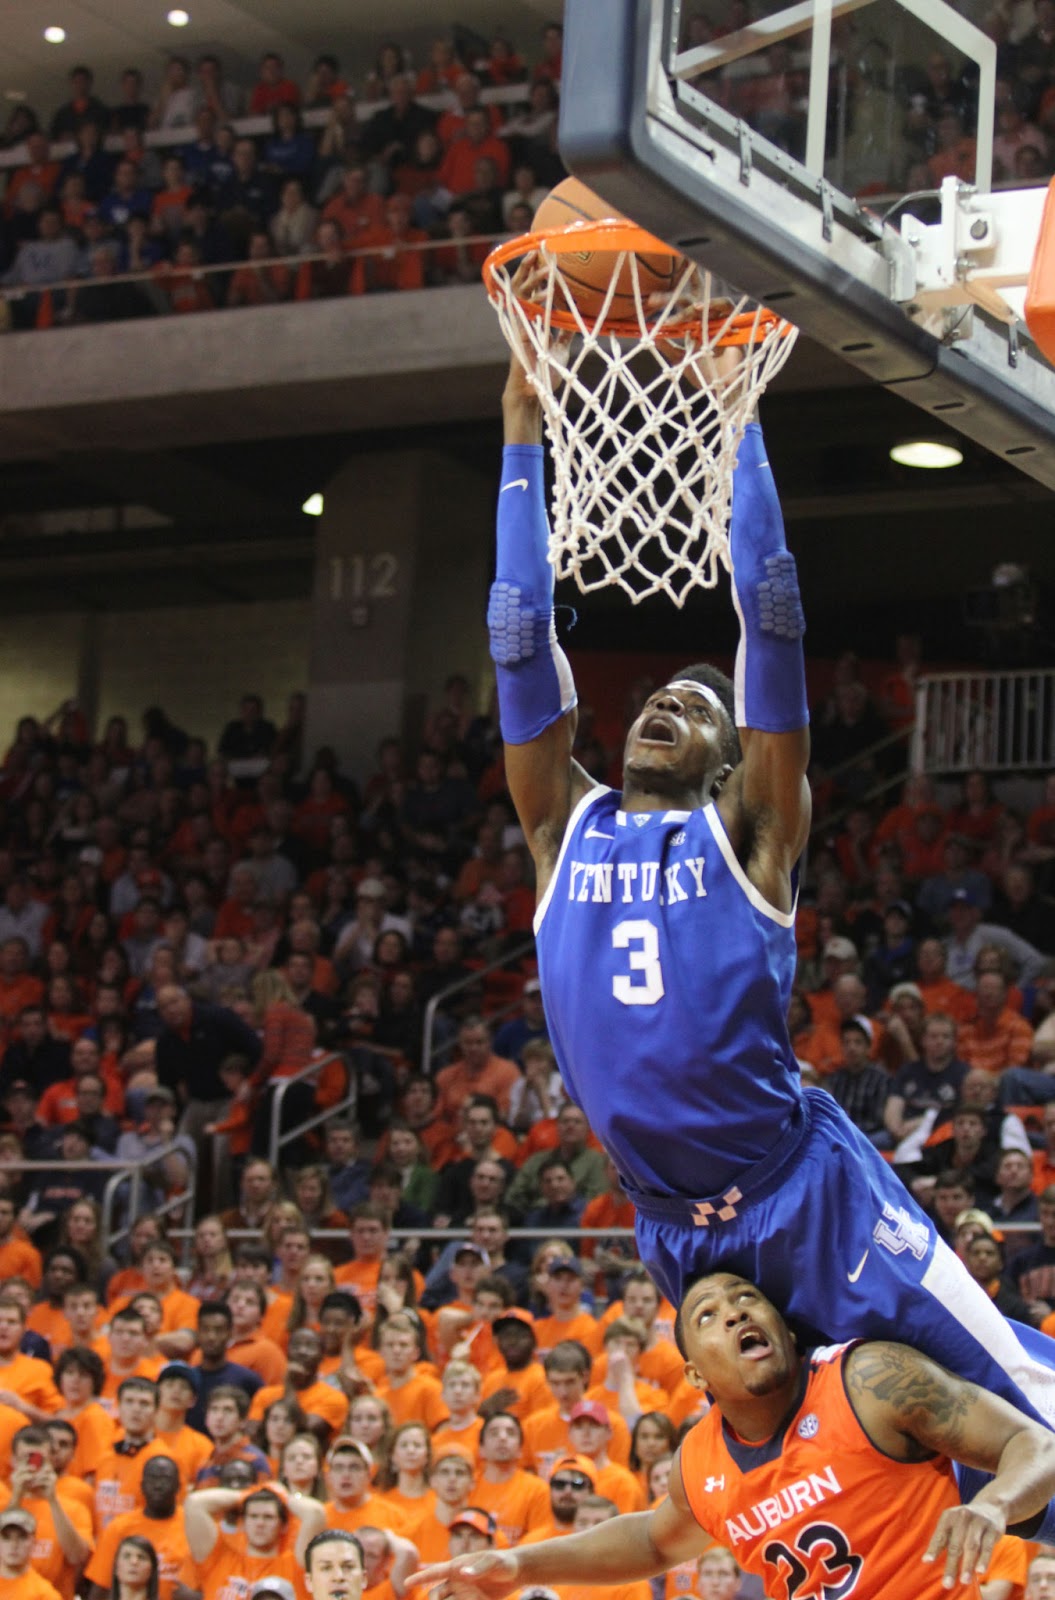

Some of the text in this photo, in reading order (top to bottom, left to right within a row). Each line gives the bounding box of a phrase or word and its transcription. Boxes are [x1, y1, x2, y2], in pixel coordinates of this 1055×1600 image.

[329, 552, 397, 600] 112
[612, 919, 665, 1005] 3
[725, 1465, 842, 1546] AUBURN
[763, 1521, 864, 1600] 23
